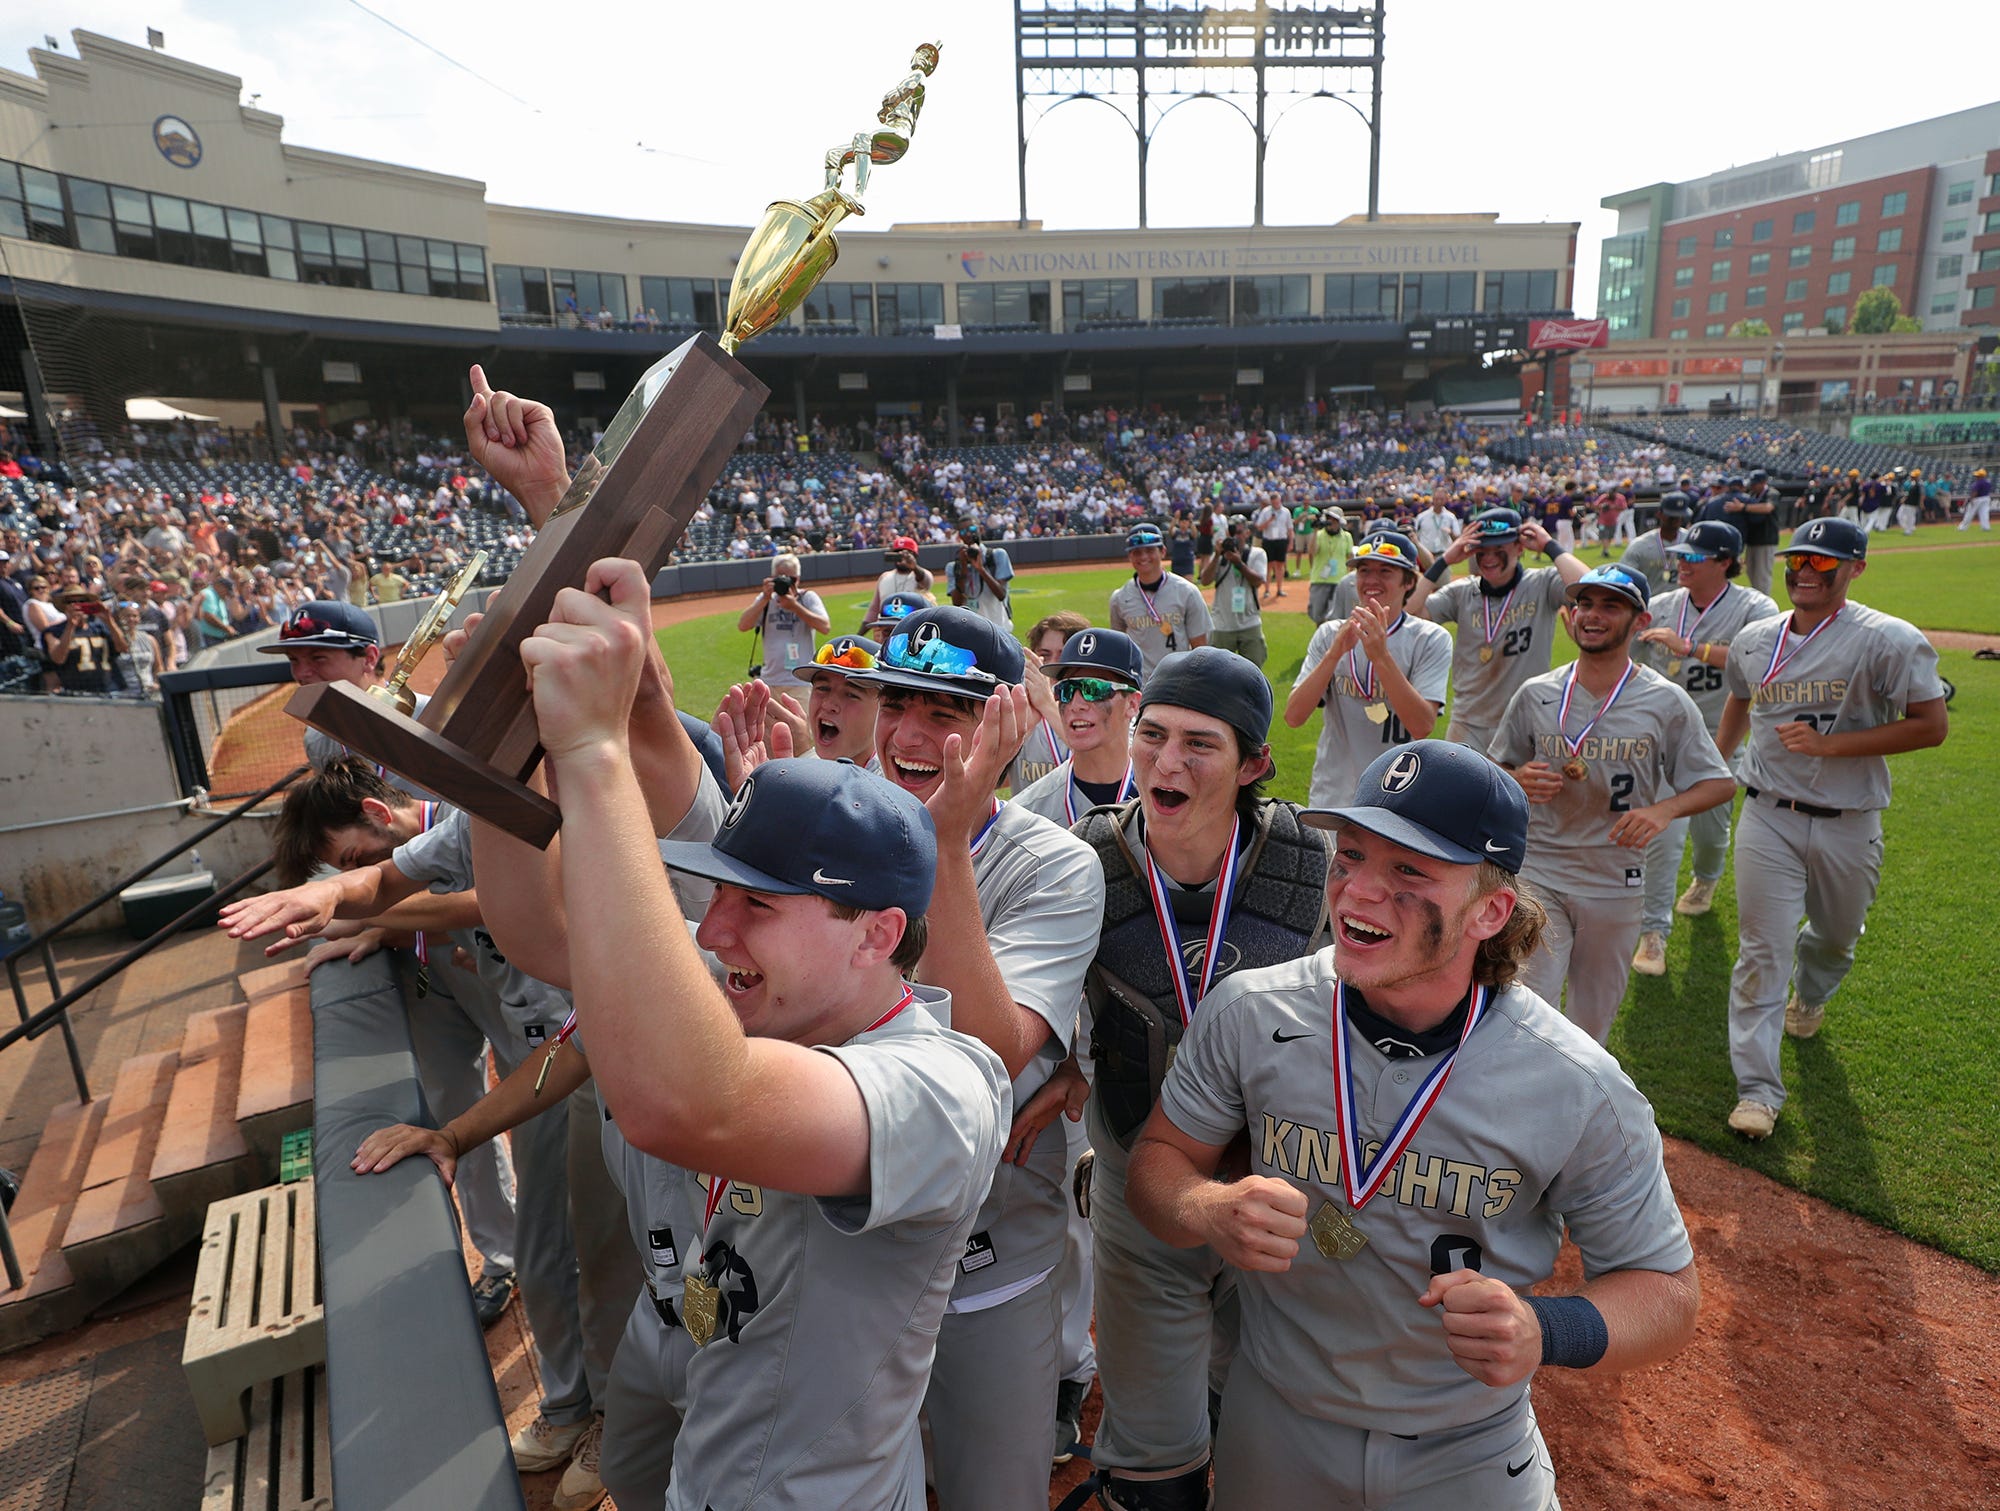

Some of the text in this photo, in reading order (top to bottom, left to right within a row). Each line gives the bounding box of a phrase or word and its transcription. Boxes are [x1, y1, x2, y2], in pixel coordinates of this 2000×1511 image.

[989, 252, 1098, 273] NATIONAL
[1108, 249, 1228, 271] INTERSTATE
[1368, 246, 1423, 265] SUITE
[1427, 245, 1481, 264] LEVEL
[1471, 601, 1537, 629] KIGHTS
[1165, 632, 1177, 651] 4
[1503, 626, 1533, 657] 23
[1686, 665, 1723, 692] 25
[1382, 711, 1412, 744] 10
[1540, 733, 1652, 761] KNGHTS
[1610, 773, 1634, 812] 2
[530, 1028, 537, 1036] S
[1262, 1111, 1524, 1219] KNGHTS
[651, 1234, 661, 1246] L
[966, 1240, 984, 1253] XL
